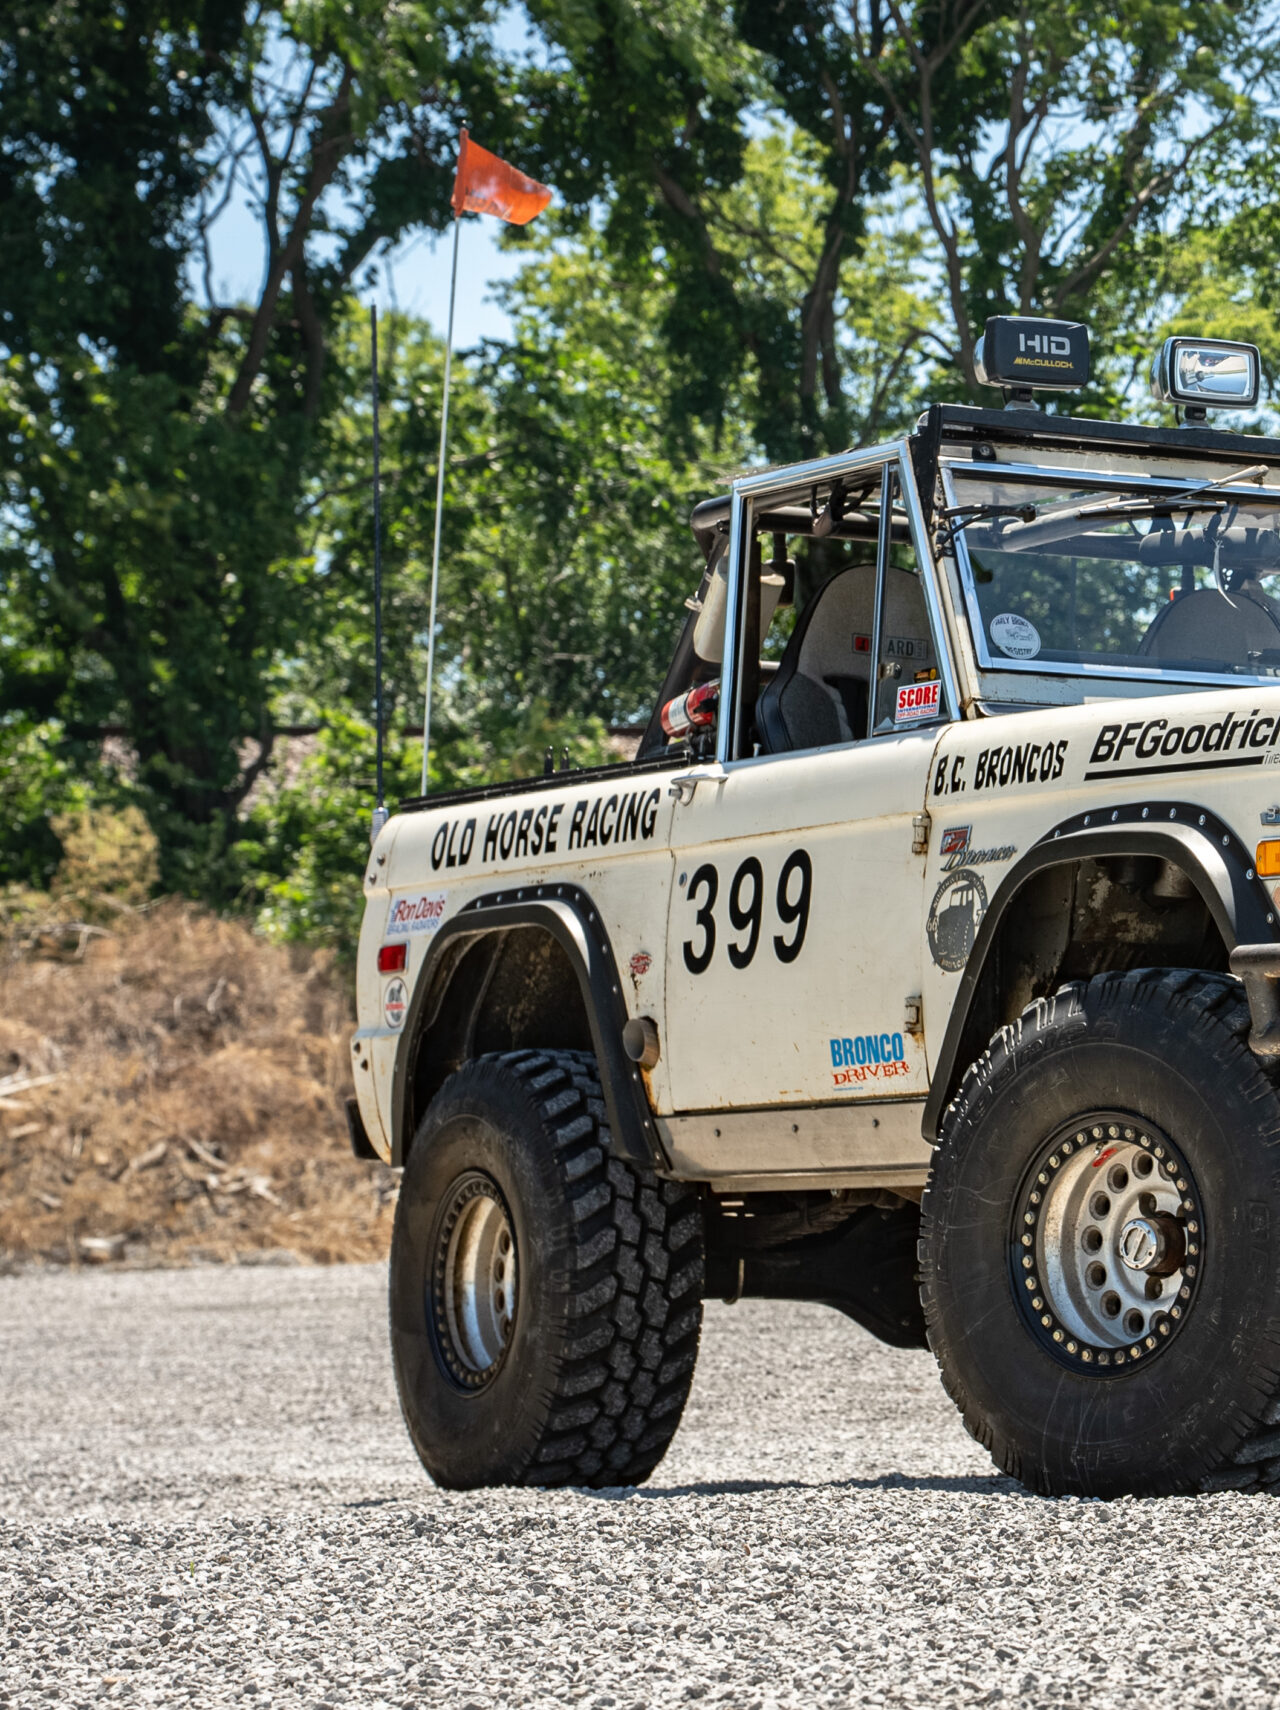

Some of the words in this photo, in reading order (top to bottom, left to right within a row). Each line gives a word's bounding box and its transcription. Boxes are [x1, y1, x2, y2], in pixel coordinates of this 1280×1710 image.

[1019, 333, 1071, 356] HID
[898, 684, 939, 709] SCORE
[933, 754, 966, 797] B.C.
[974, 739, 1069, 791] BRONCOS
[430, 817, 478, 871] OLD
[482, 803, 565, 864] HORSE
[568, 787, 661, 850] RACING
[414, 896, 446, 919] Davis
[682, 848, 814, 976] 399
[926, 914, 940, 933] 66
[830, 1032, 905, 1068] BRONCO
[833, 1060, 911, 1086] DRIVER
